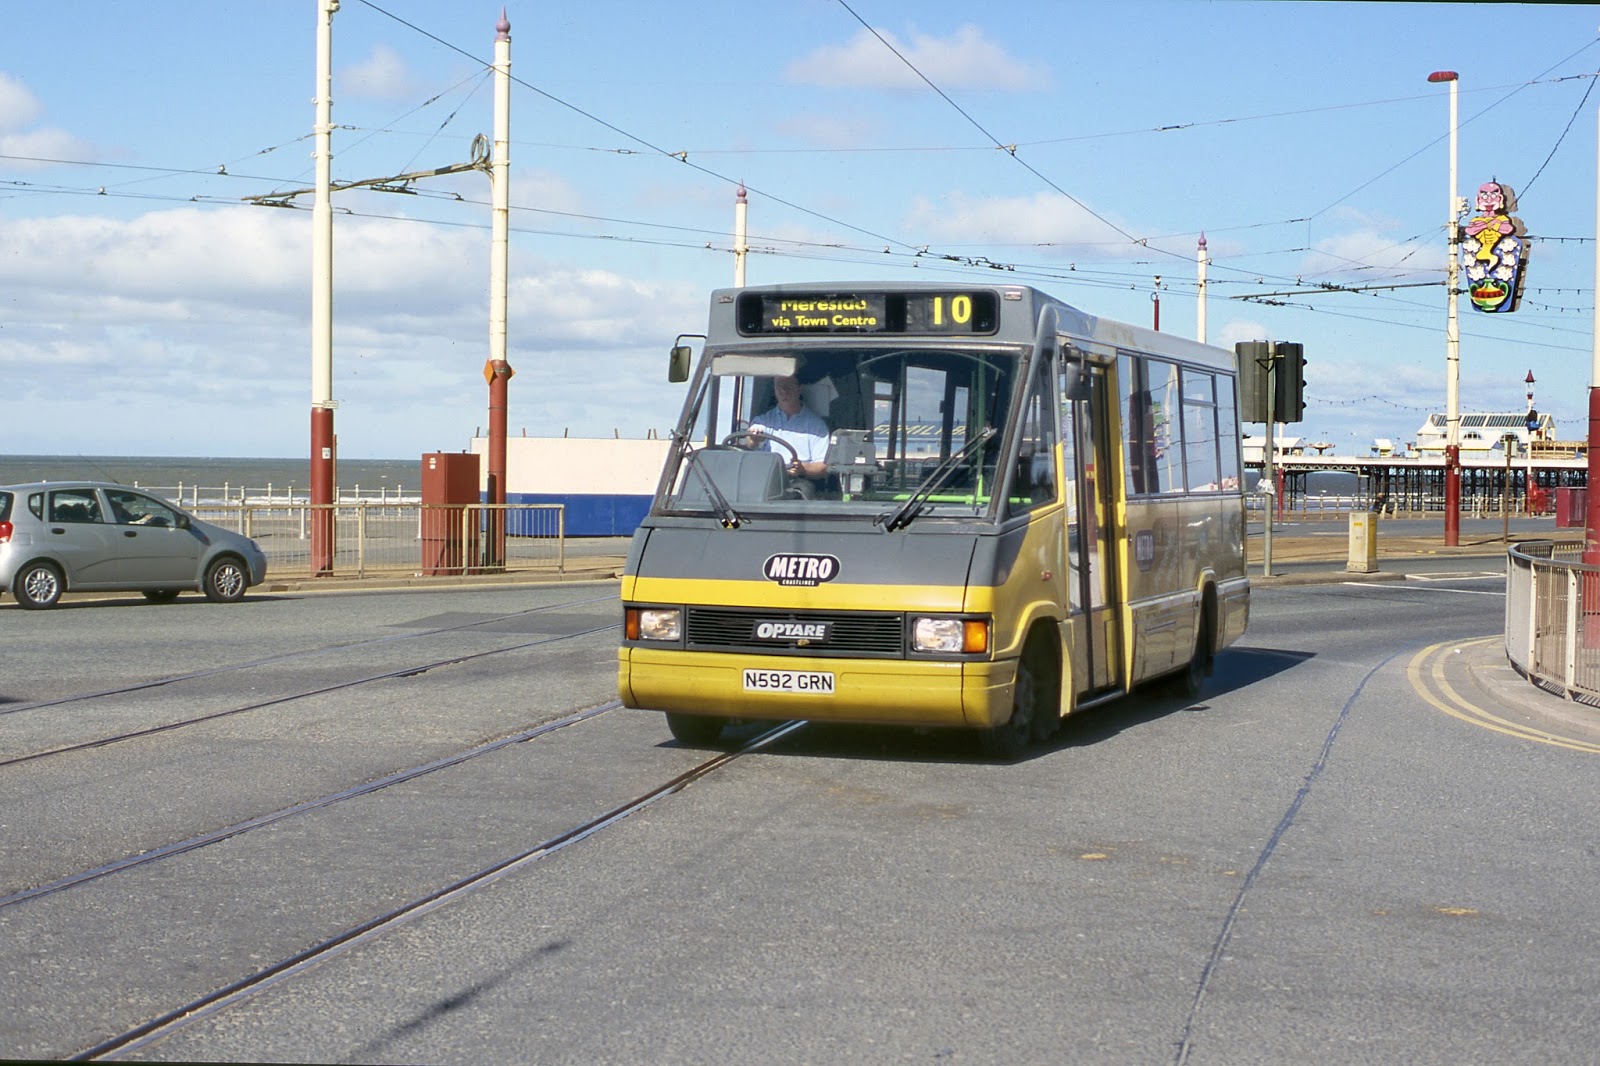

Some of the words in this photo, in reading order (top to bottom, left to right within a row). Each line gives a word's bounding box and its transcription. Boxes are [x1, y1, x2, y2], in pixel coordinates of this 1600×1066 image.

[933, 295, 972, 325] 10
[772, 316, 791, 327] via
[795, 315, 828, 326] Town
[832, 315, 877, 326] Centre
[769, 557, 832, 579] METRO
[757, 623, 826, 639] OPTARE
[745, 672, 793, 689] N592
[797, 674, 833, 691] GRN
